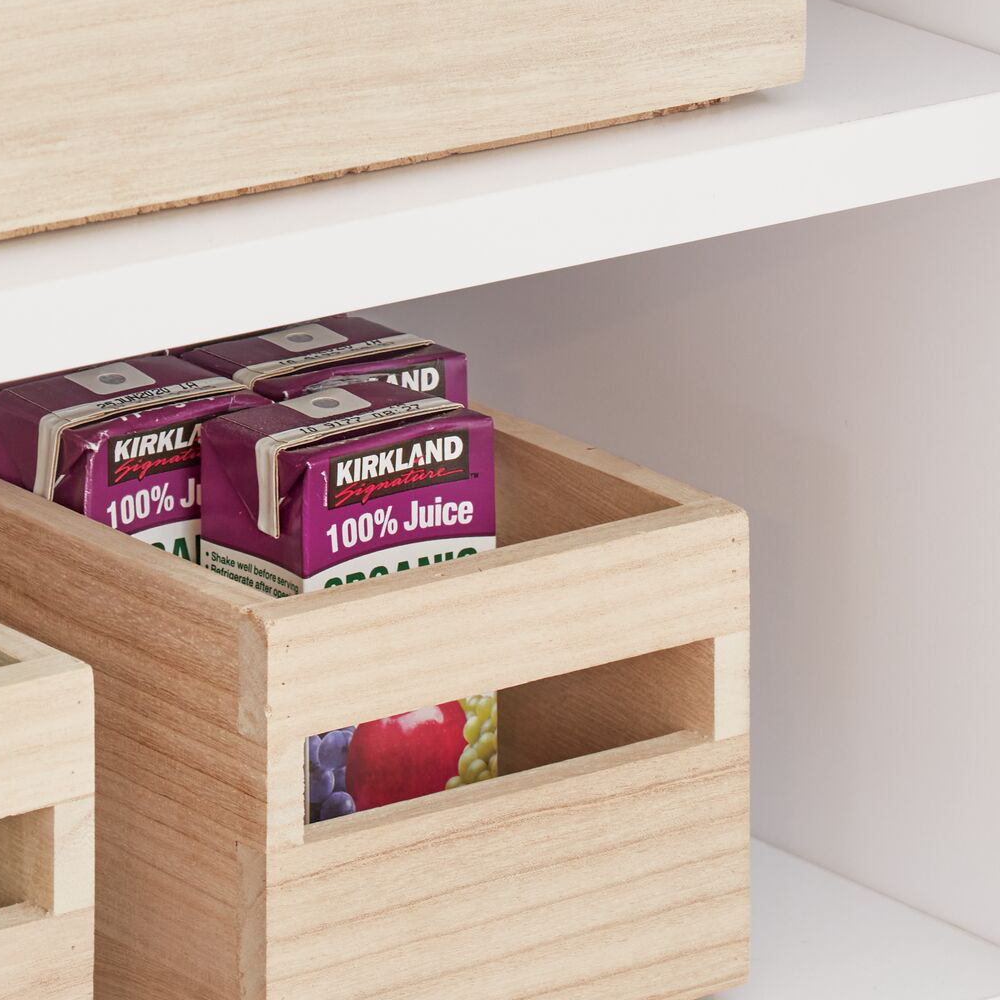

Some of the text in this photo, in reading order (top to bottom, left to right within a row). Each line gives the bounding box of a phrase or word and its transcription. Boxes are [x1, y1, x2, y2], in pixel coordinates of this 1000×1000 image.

[336, 435, 464, 487] KIRKLAND
[106, 482, 175, 529] 100%
[334, 467, 464, 507] Signature
[326, 497, 474, 553] 100% Juice
[211, 551, 299, 595] Shake well before serving
[255, 581, 272, 594] after
